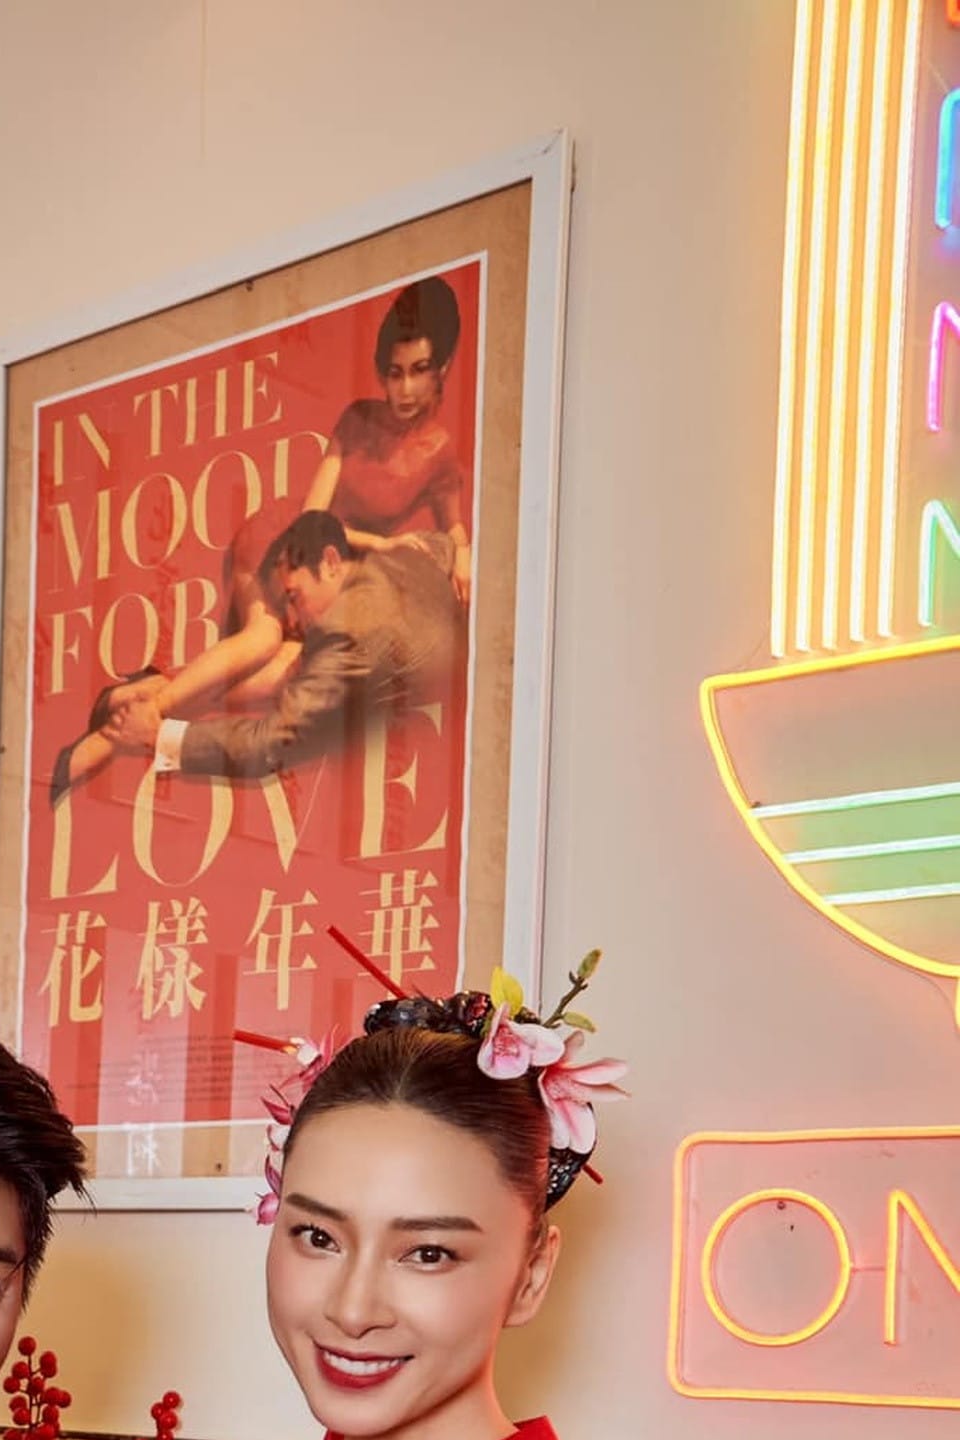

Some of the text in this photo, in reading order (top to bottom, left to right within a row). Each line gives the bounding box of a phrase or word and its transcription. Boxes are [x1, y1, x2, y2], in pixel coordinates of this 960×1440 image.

[49, 351, 283, 487] IN THE
[48, 577, 220, 695] FOR
[48, 702, 449, 899] LOVE
[37, 868, 440, 1028] 花樣年華
